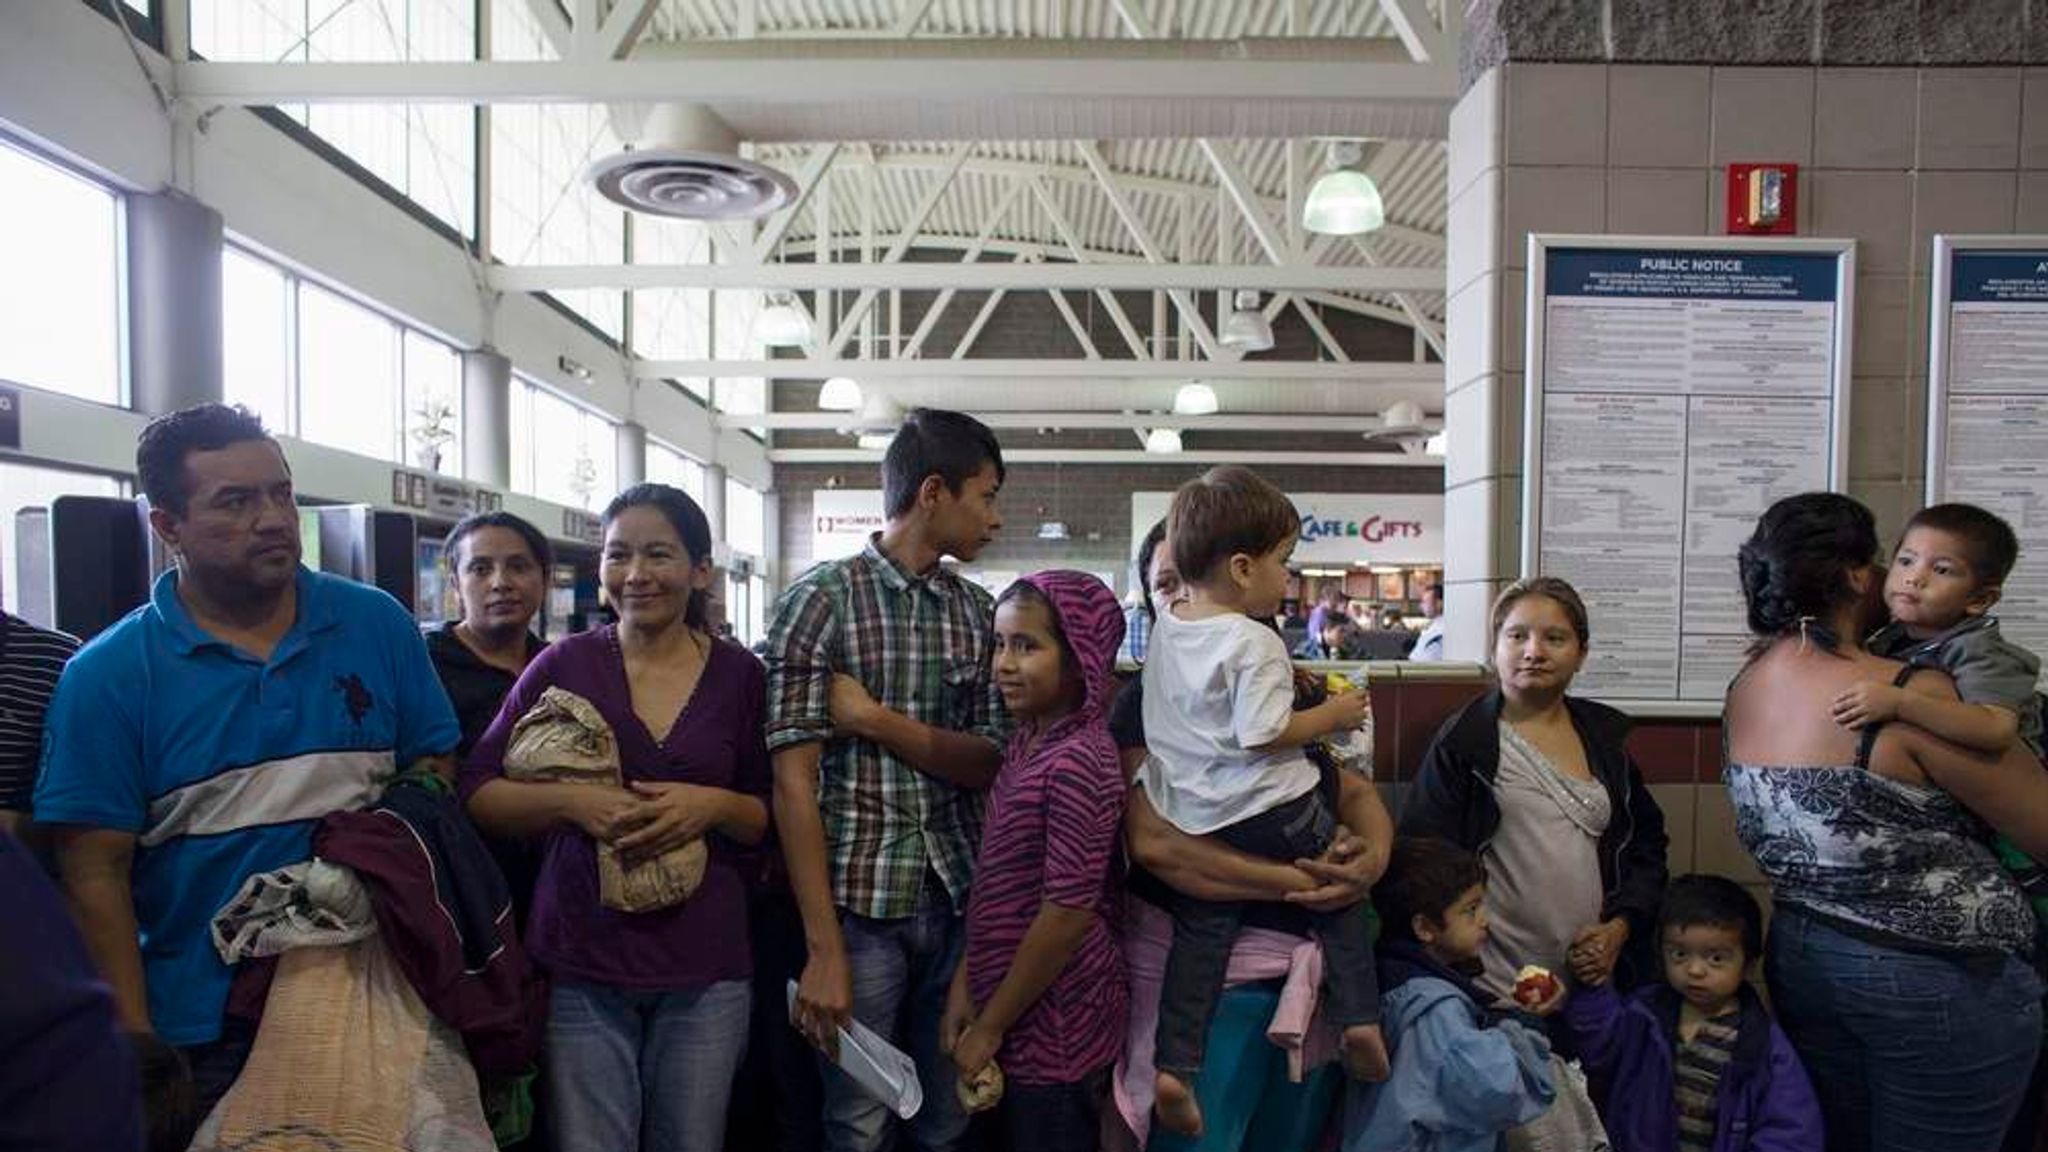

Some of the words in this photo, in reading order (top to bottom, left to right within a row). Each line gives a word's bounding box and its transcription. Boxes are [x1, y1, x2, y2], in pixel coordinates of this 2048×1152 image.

[1640, 259, 1688, 270] PUBLIC
[1692, 260, 1742, 272] NOTICE
[836, 516, 882, 525] WOMEN
